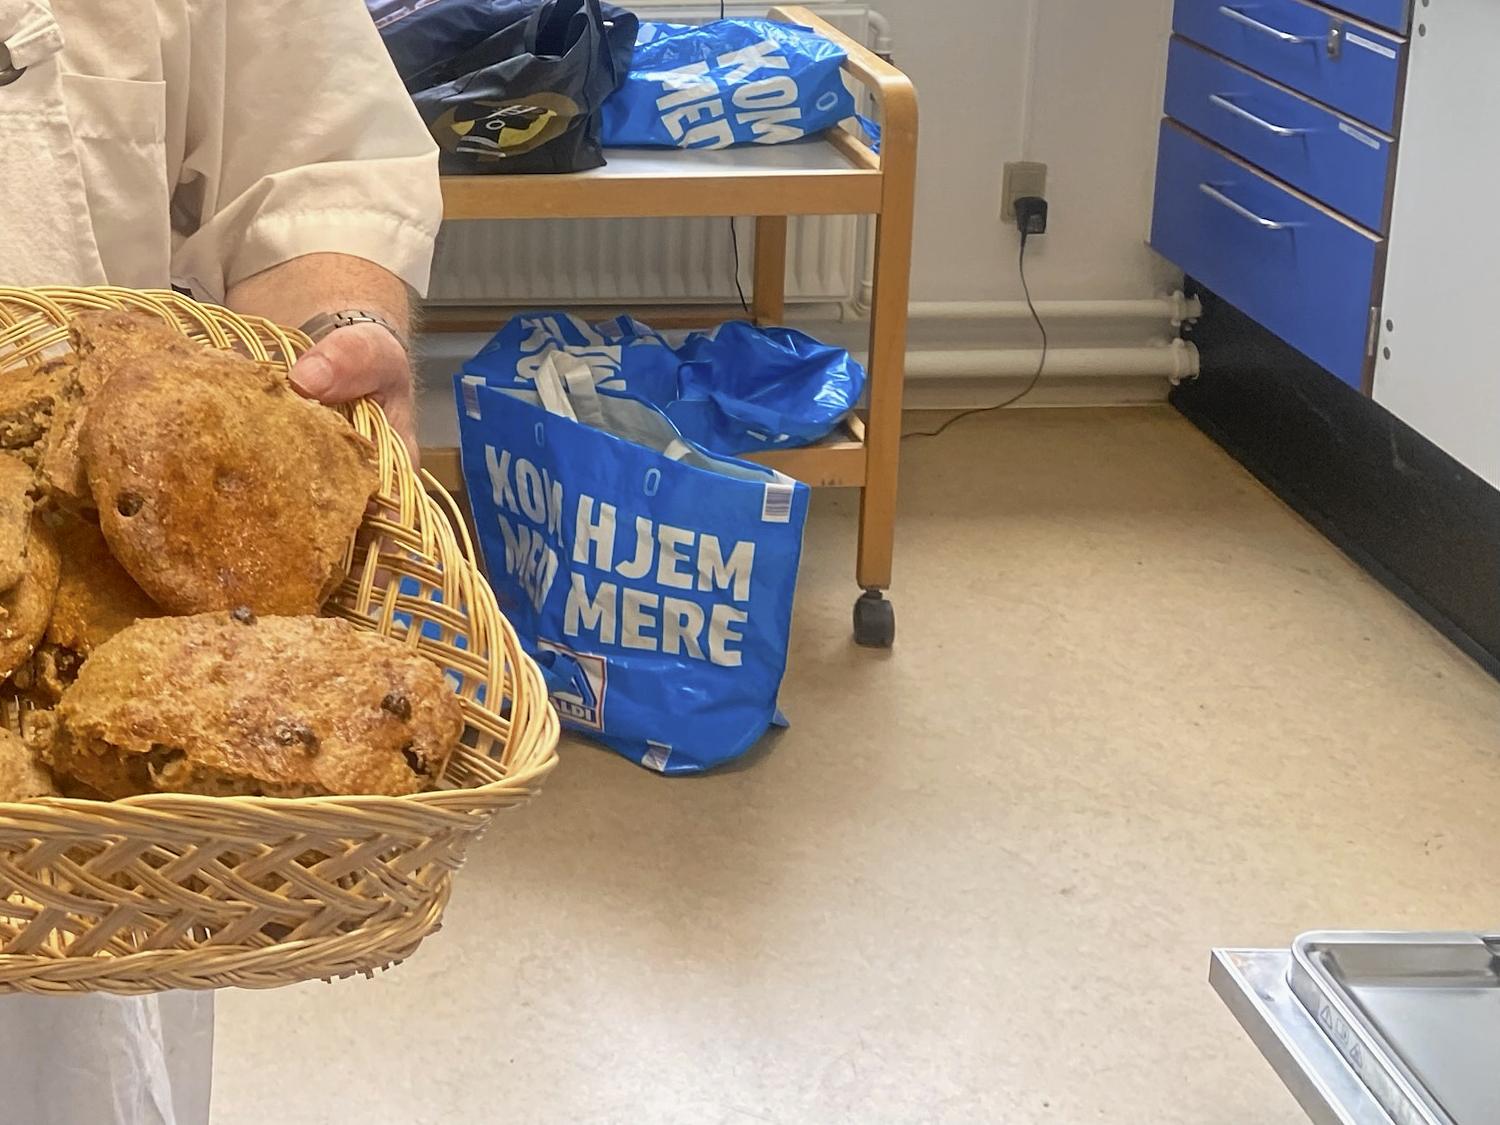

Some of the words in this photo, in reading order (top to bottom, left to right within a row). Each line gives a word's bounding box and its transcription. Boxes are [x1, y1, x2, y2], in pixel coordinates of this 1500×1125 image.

[716, 39, 805, 144] KOM
[573, 494, 755, 601] HJEM
[564, 572, 748, 666] MERE
